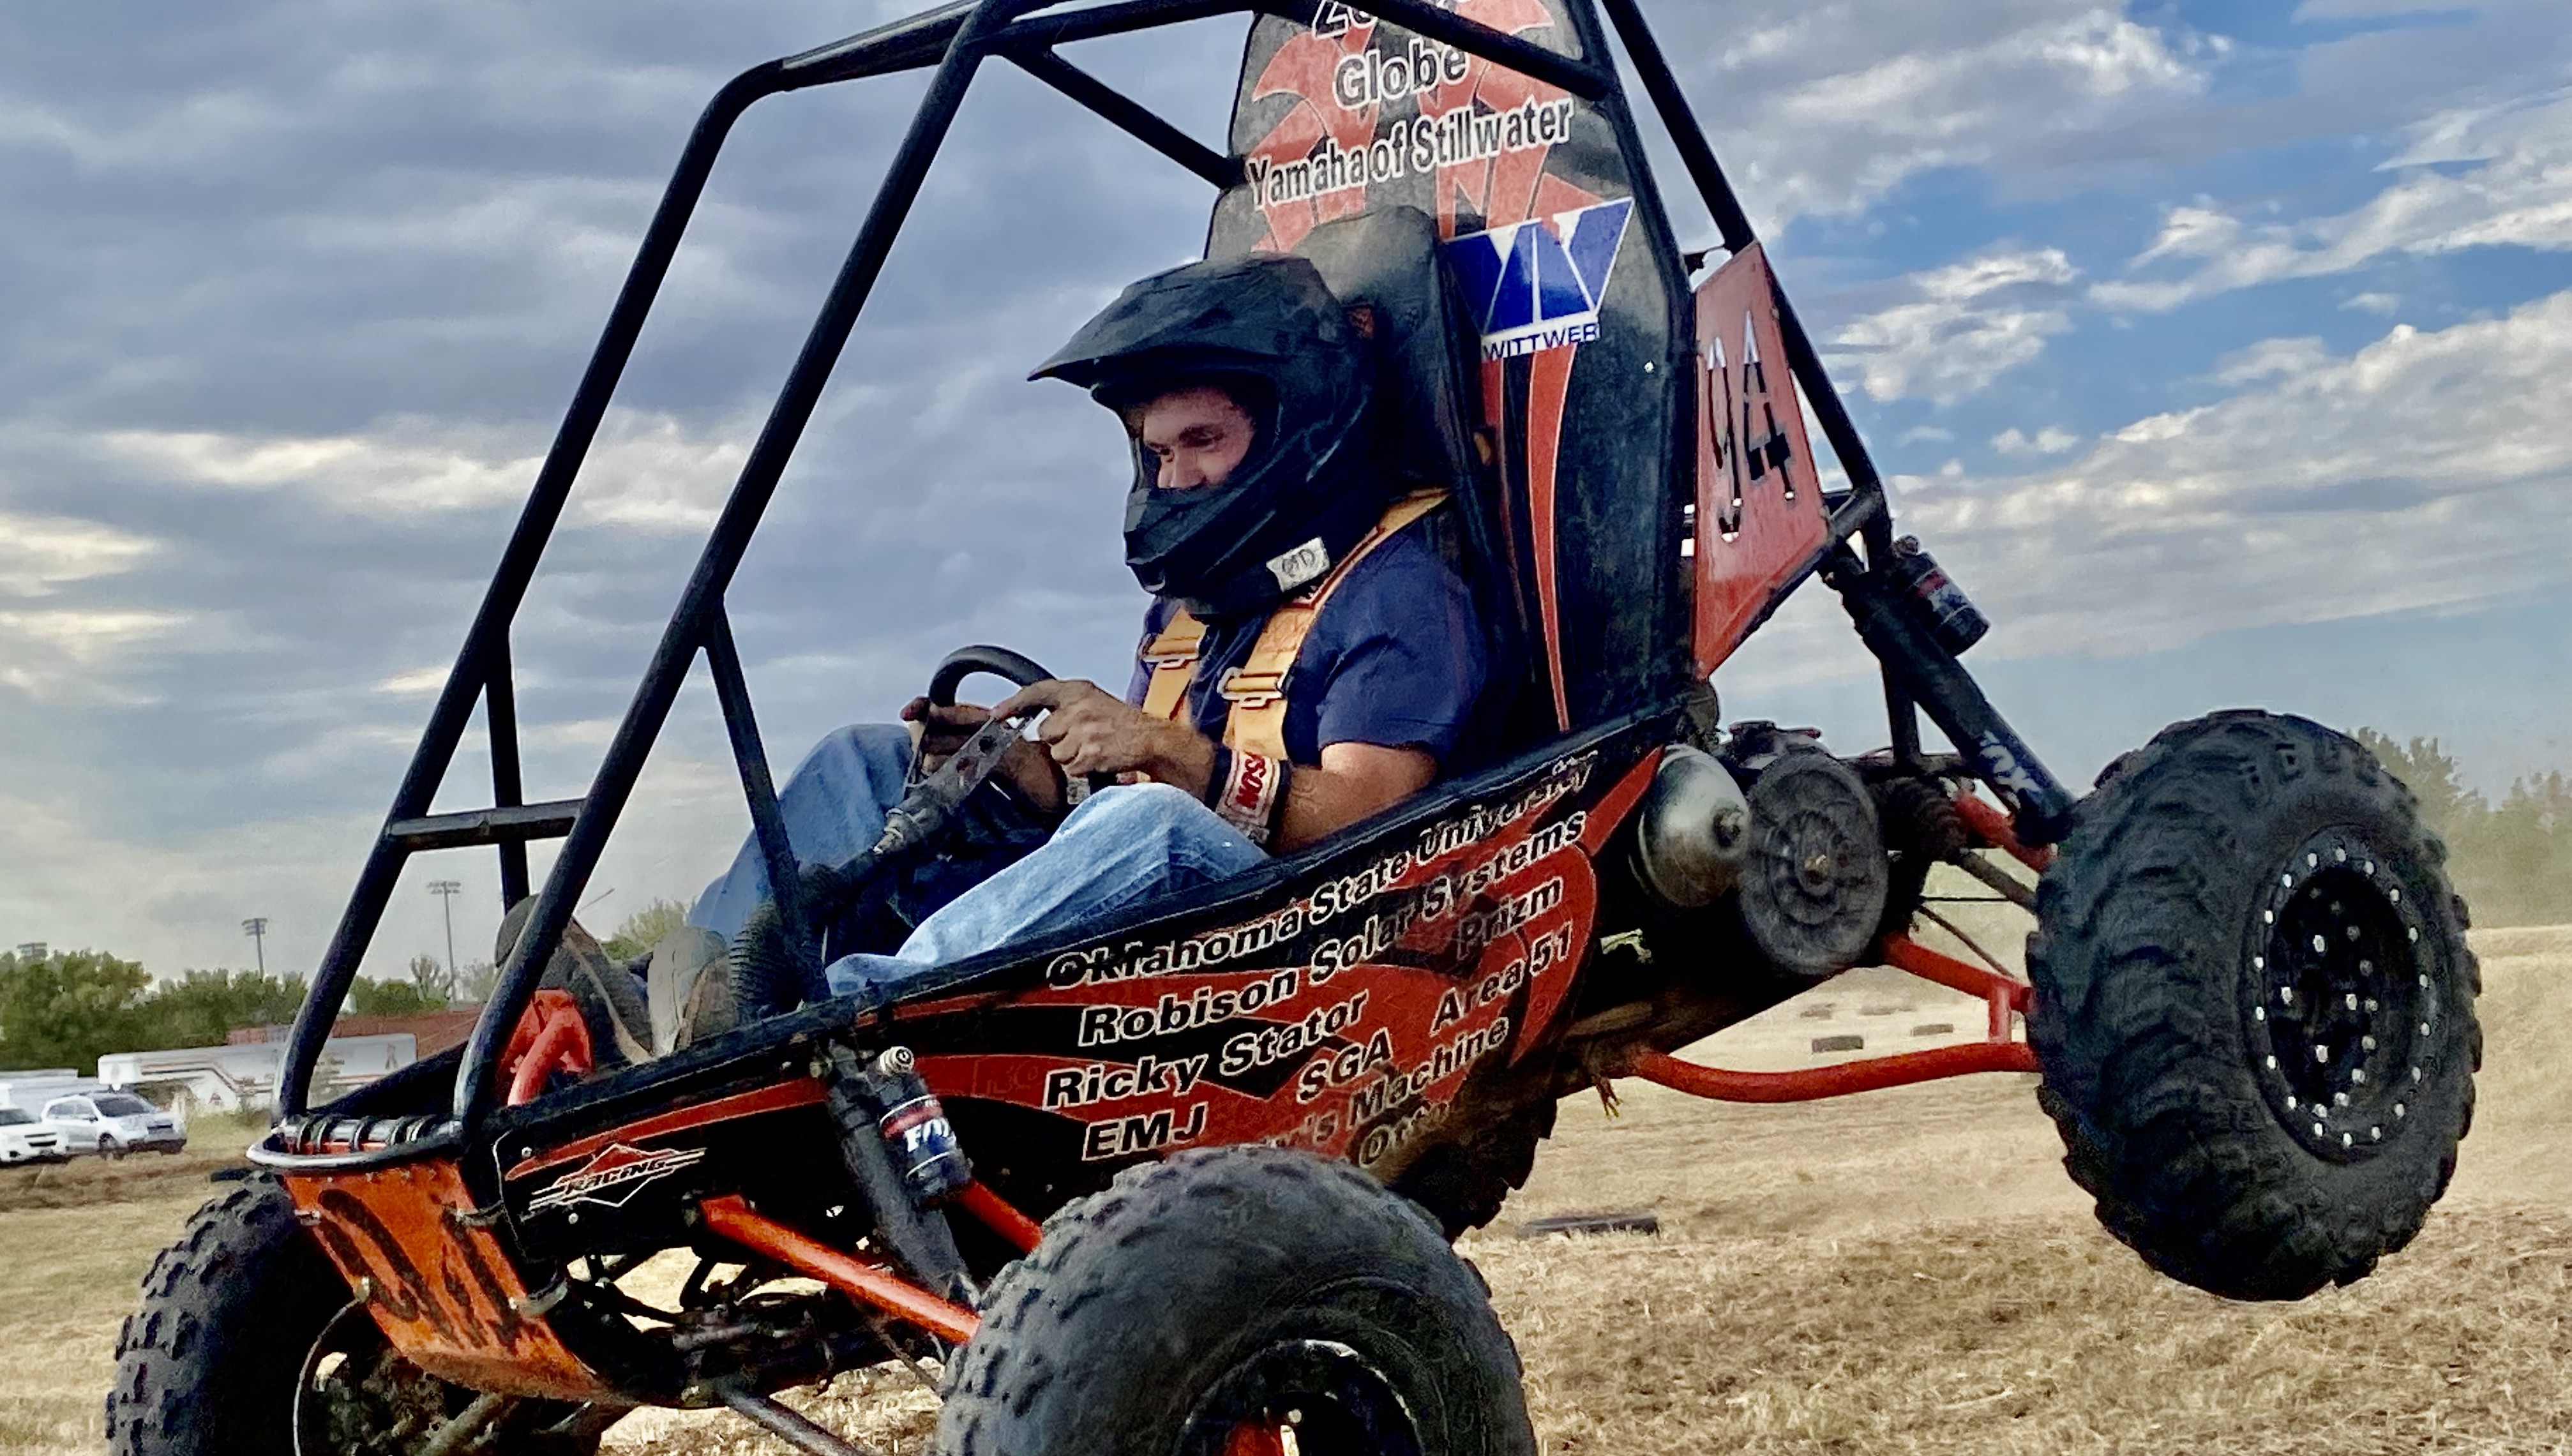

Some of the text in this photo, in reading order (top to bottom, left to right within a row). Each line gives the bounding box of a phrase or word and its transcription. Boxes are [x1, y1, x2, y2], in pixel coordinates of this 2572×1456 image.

[1332, 36, 1470, 110] Globe
[1247, 97, 1575, 209] Yamaha of Stillwater
[1482, 322, 1601, 359] WITTWER
[1235, 751, 1267, 810] SON
[1046, 908, 1303, 990] Oklahoma
[1309, 850, 1411, 926] State
[1456, 876, 1563, 958] Prizm
[1078, 968, 1298, 1047] Robison
[1309, 903, 1415, 986] Solar
[1429, 920, 1573, 1037] Area 51
[1042, 1054, 1208, 1111] Ricky
[1219, 989, 1369, 1077] Stator
[1082, 1101, 1208, 1161] EMJ
[1297, 1027, 1394, 1105] SGA
[1346, 1017, 1510, 1130] Machine
